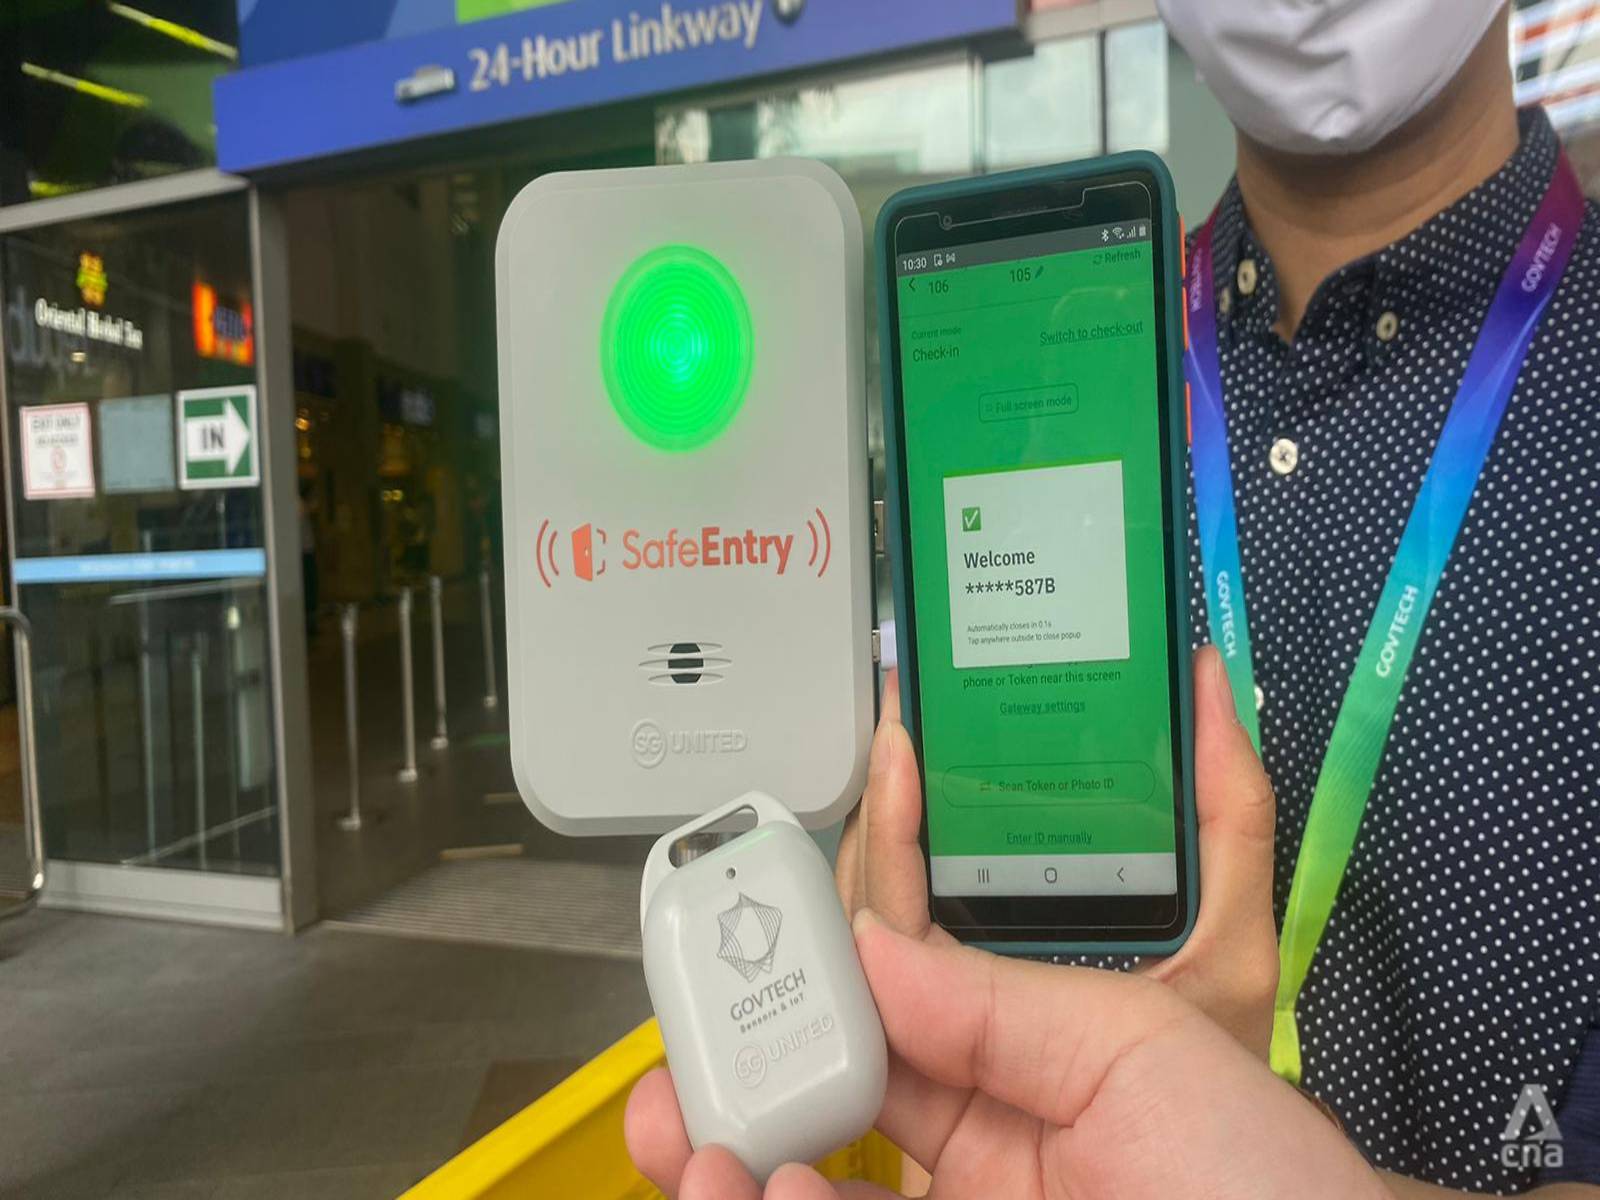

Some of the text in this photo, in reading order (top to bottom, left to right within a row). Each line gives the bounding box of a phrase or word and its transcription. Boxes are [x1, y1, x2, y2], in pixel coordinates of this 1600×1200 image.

[467, 0, 764, 92] 24-Hour Linkway
[903, 257, 927, 271] 10:30
[1104, 250, 1141, 264] Refresh
[1009, 267, 1031, 283] 105
[928, 279, 949, 295] 106
[940, 327, 961, 337] mode
[1040, 321, 1144, 345] Switch to check-out
[912, 345, 960, 362] Check-in
[995, 394, 1072, 414] Full screen mode
[201, 423, 225, 450] IN
[622, 526, 794, 576] SafeEntry
[963, 550, 1035, 569] Welcome
[1216, 569, 1237, 659] GOVTECH
[967, 622, 1009, 633] Automatically
[1010, 620, 1030, 631] closes
[1031, 620, 1038, 629] in
[1376, 584, 1419, 678] GOVTECH
[968, 631, 1081, 646] Tap anywhere outside to close popup
[963, 670, 1121, 690] phone or Token near this screen
[1000, 699, 1086, 716] Gateway settings
[669, 728, 749, 754] UNITED
[998, 777, 1114, 792] Scan Token or Photo ID
[1006, 830, 1093, 846] Enter ID manually
[730, 968, 807, 1022] GOVTECH
[740, 1008, 778, 1035] Sensors
[768, 1014, 835, 1062] UNITED
